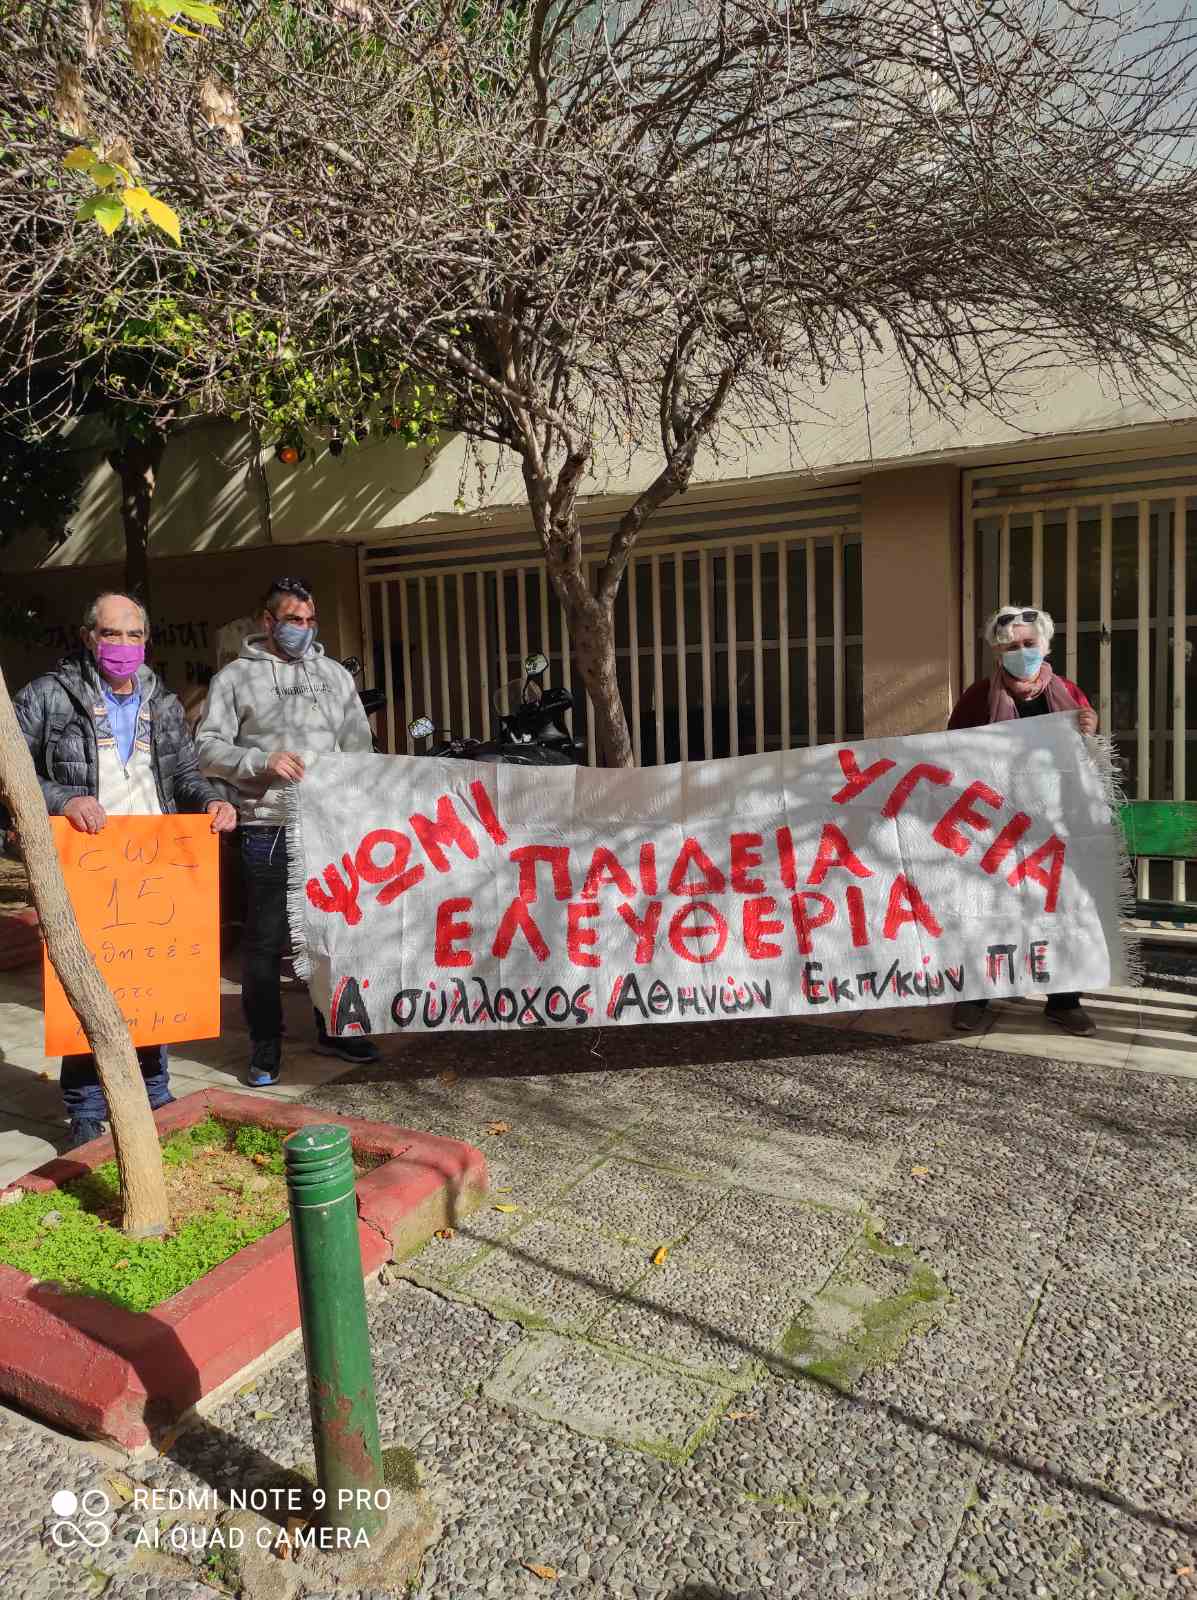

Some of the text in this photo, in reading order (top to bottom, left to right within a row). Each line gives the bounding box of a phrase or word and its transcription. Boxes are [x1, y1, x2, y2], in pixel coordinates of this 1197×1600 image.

[306, 749, 1066, 926] ΨΩΜΙ ΠΑΙΔΕΙΑ ΥΓΕΙΑ
[101, 877, 175, 929] 15
[434, 873, 943, 967] ΕΛΕΥΘΕΡΙΑ
